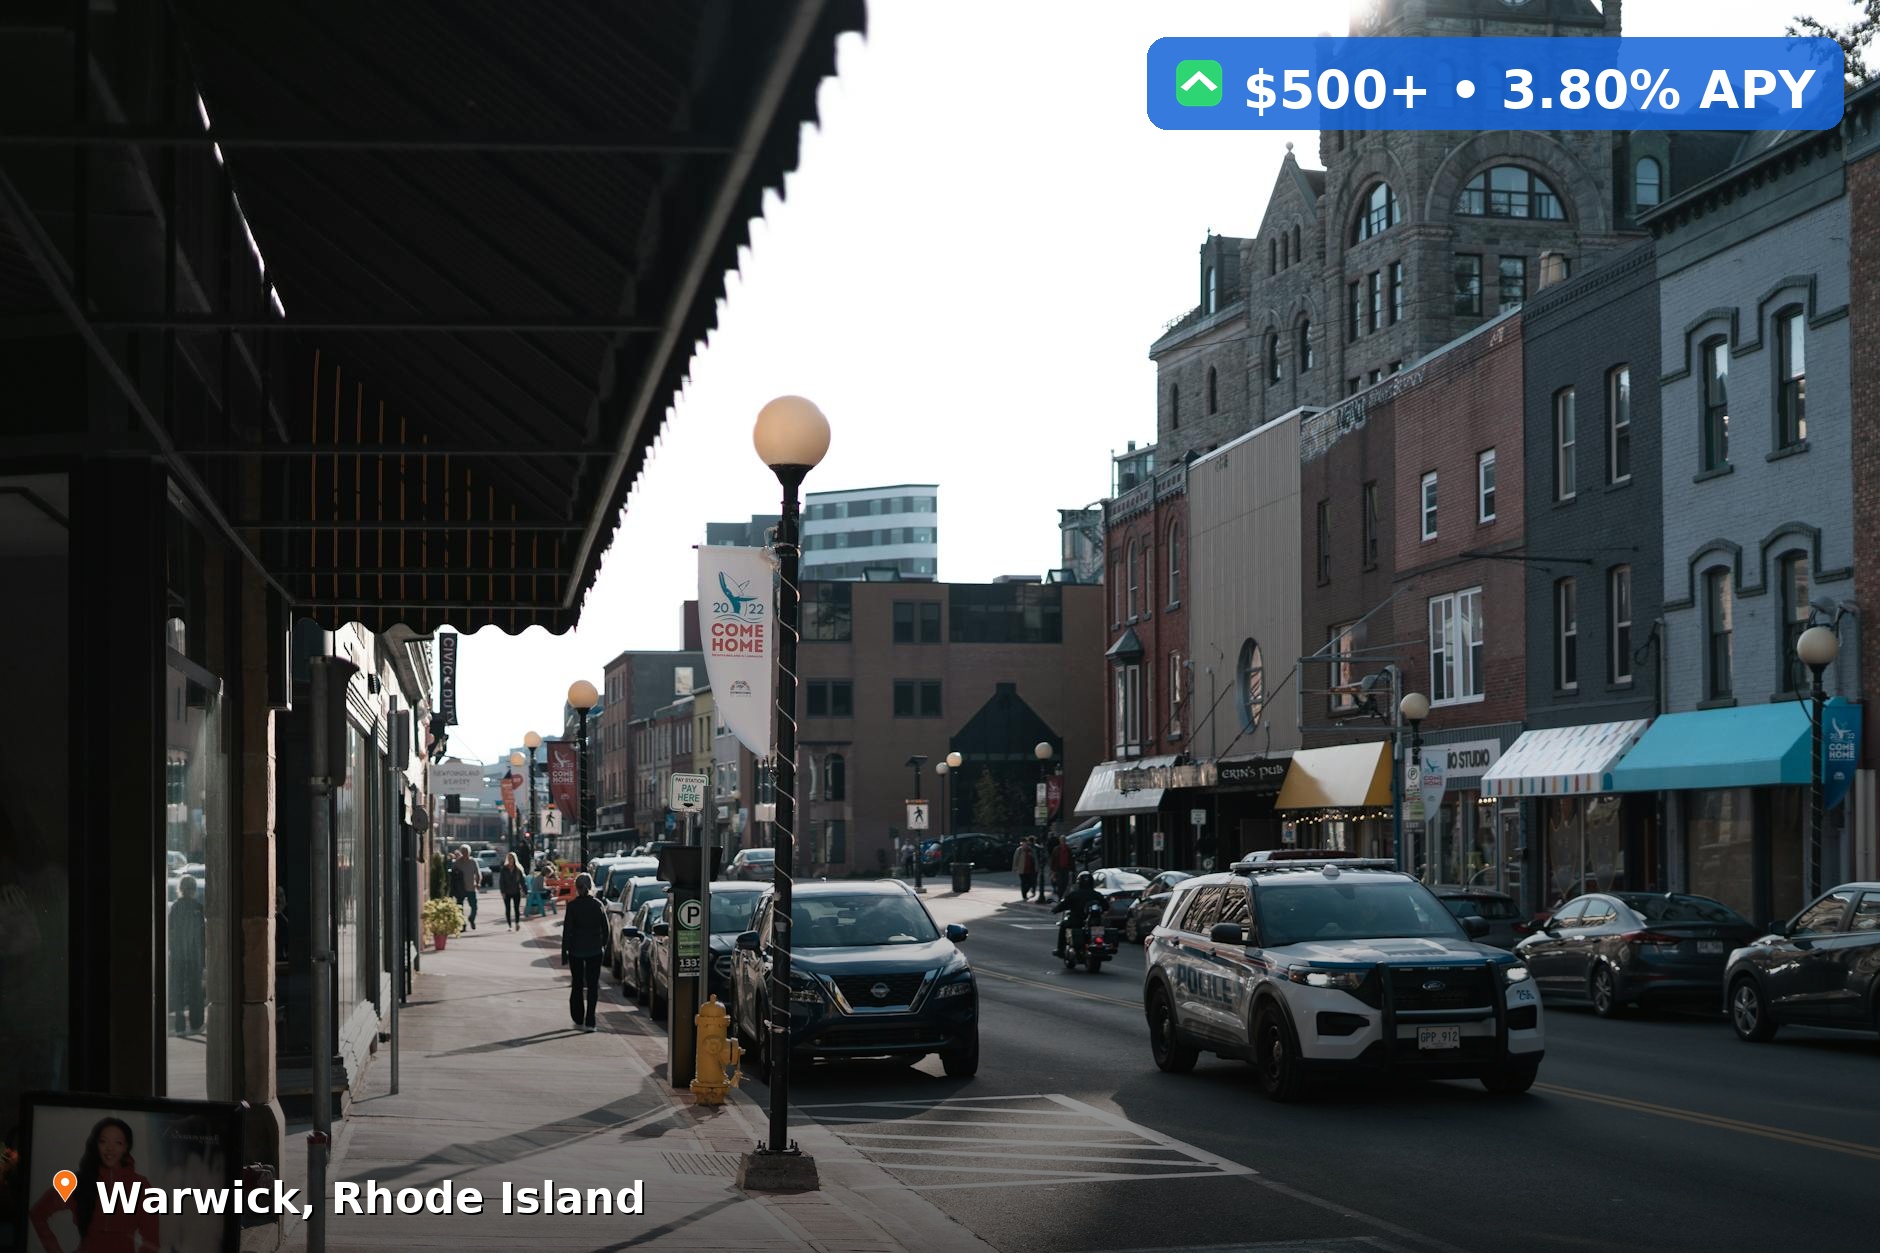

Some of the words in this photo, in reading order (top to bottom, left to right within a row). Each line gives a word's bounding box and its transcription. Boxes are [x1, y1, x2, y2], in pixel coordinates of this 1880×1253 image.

[711, 623, 764, 638] COME
[711, 638, 764, 653] HOME
[443, 637, 455, 676] CIVIC
[1828, 743, 1855, 751] COME
[1459, 748, 1490, 769] STUDIO
[1828, 751, 1855, 759] HOME
[681, 784, 697, 793] PAY
[677, 793, 701, 803] HERE
[687, 906, 700, 924] P
[1176, 963, 1236, 1006] POLICE
[1420, 1031, 1437, 1043] GPP
[1441, 1030, 1458, 1042] 912
